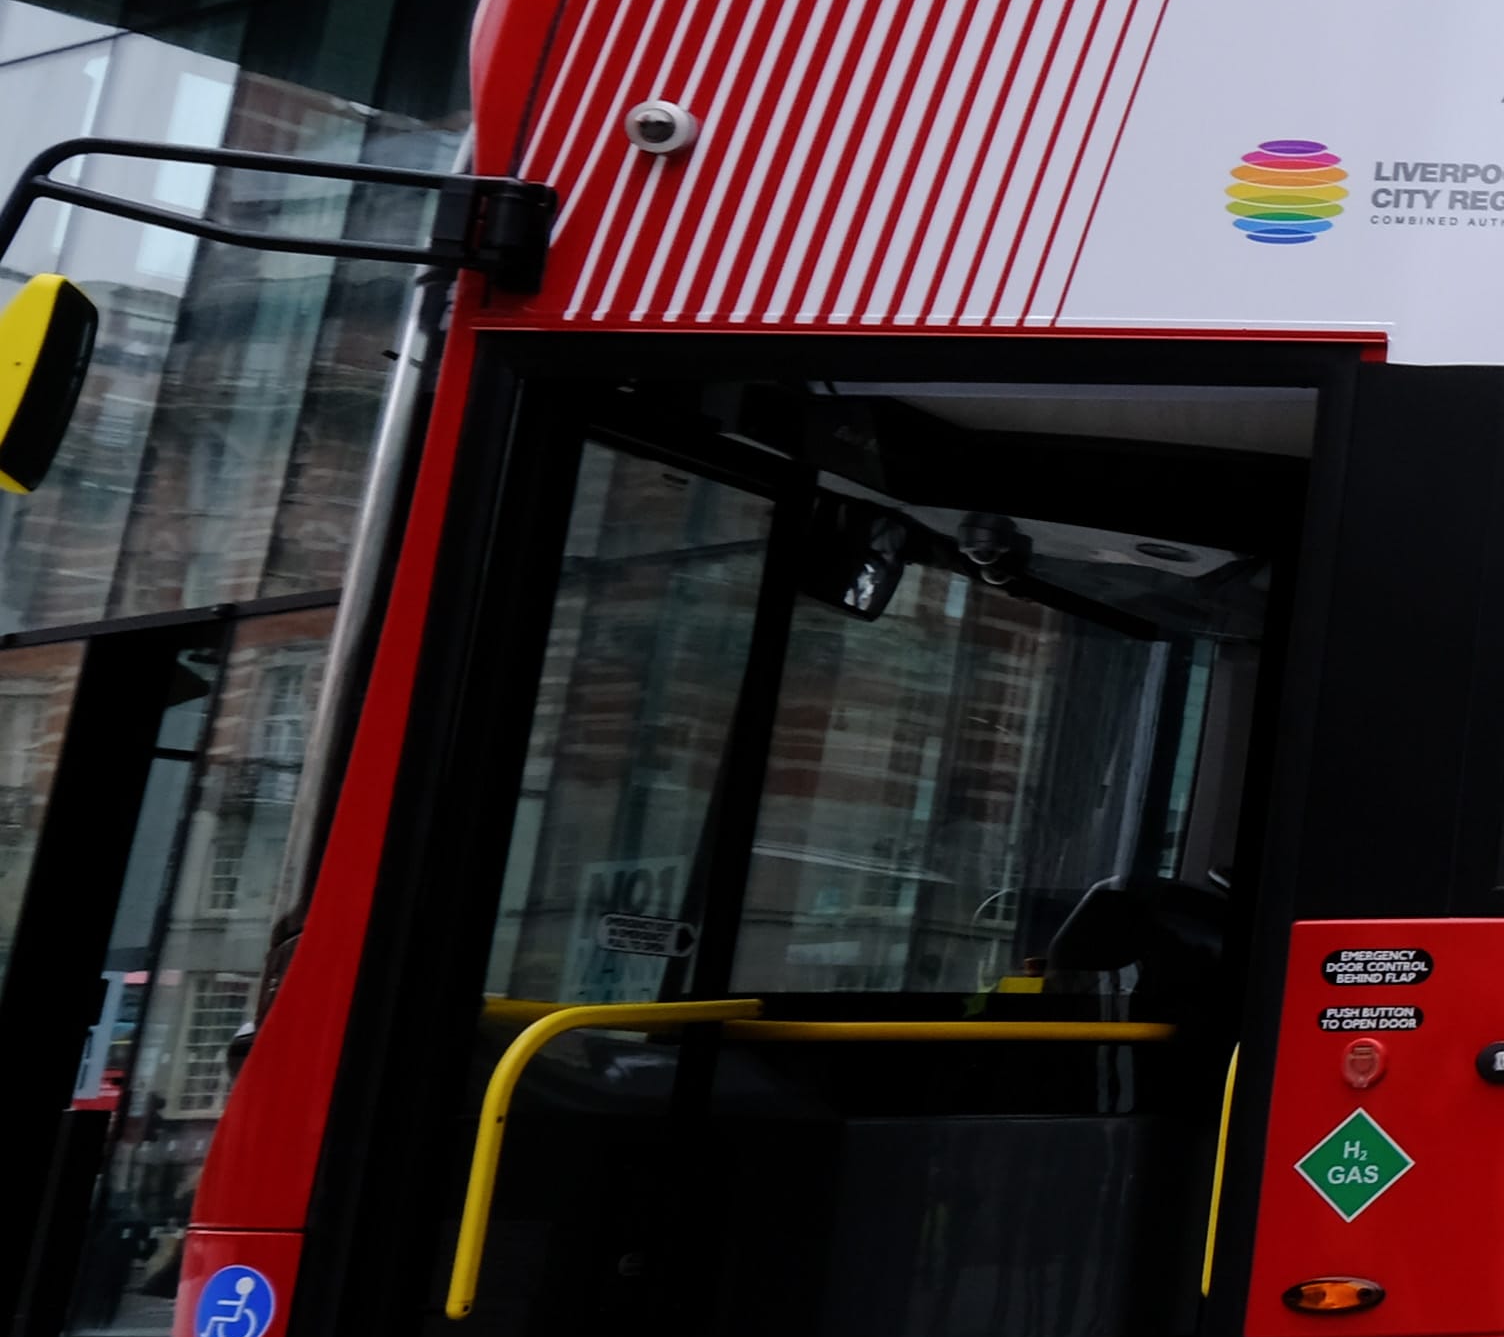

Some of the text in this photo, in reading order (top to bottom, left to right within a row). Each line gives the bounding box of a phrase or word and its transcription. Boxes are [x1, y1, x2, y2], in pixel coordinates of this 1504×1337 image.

[1371, 187, 1442, 210] CITY
[1370, 214, 1459, 226] COMBINED
[1340, 950, 1416, 961] EMERGENCY
[1326, 961, 1428, 972] DOOR CONTROL
[1336, 972, 1417, 983] BEHIND FLAP
[1326, 1007, 1415, 1018] PUSH BUTTON
[1321, 1018, 1417, 1029] TO OPEN DOOR
[1326, 1164, 1380, 1186] GAS
